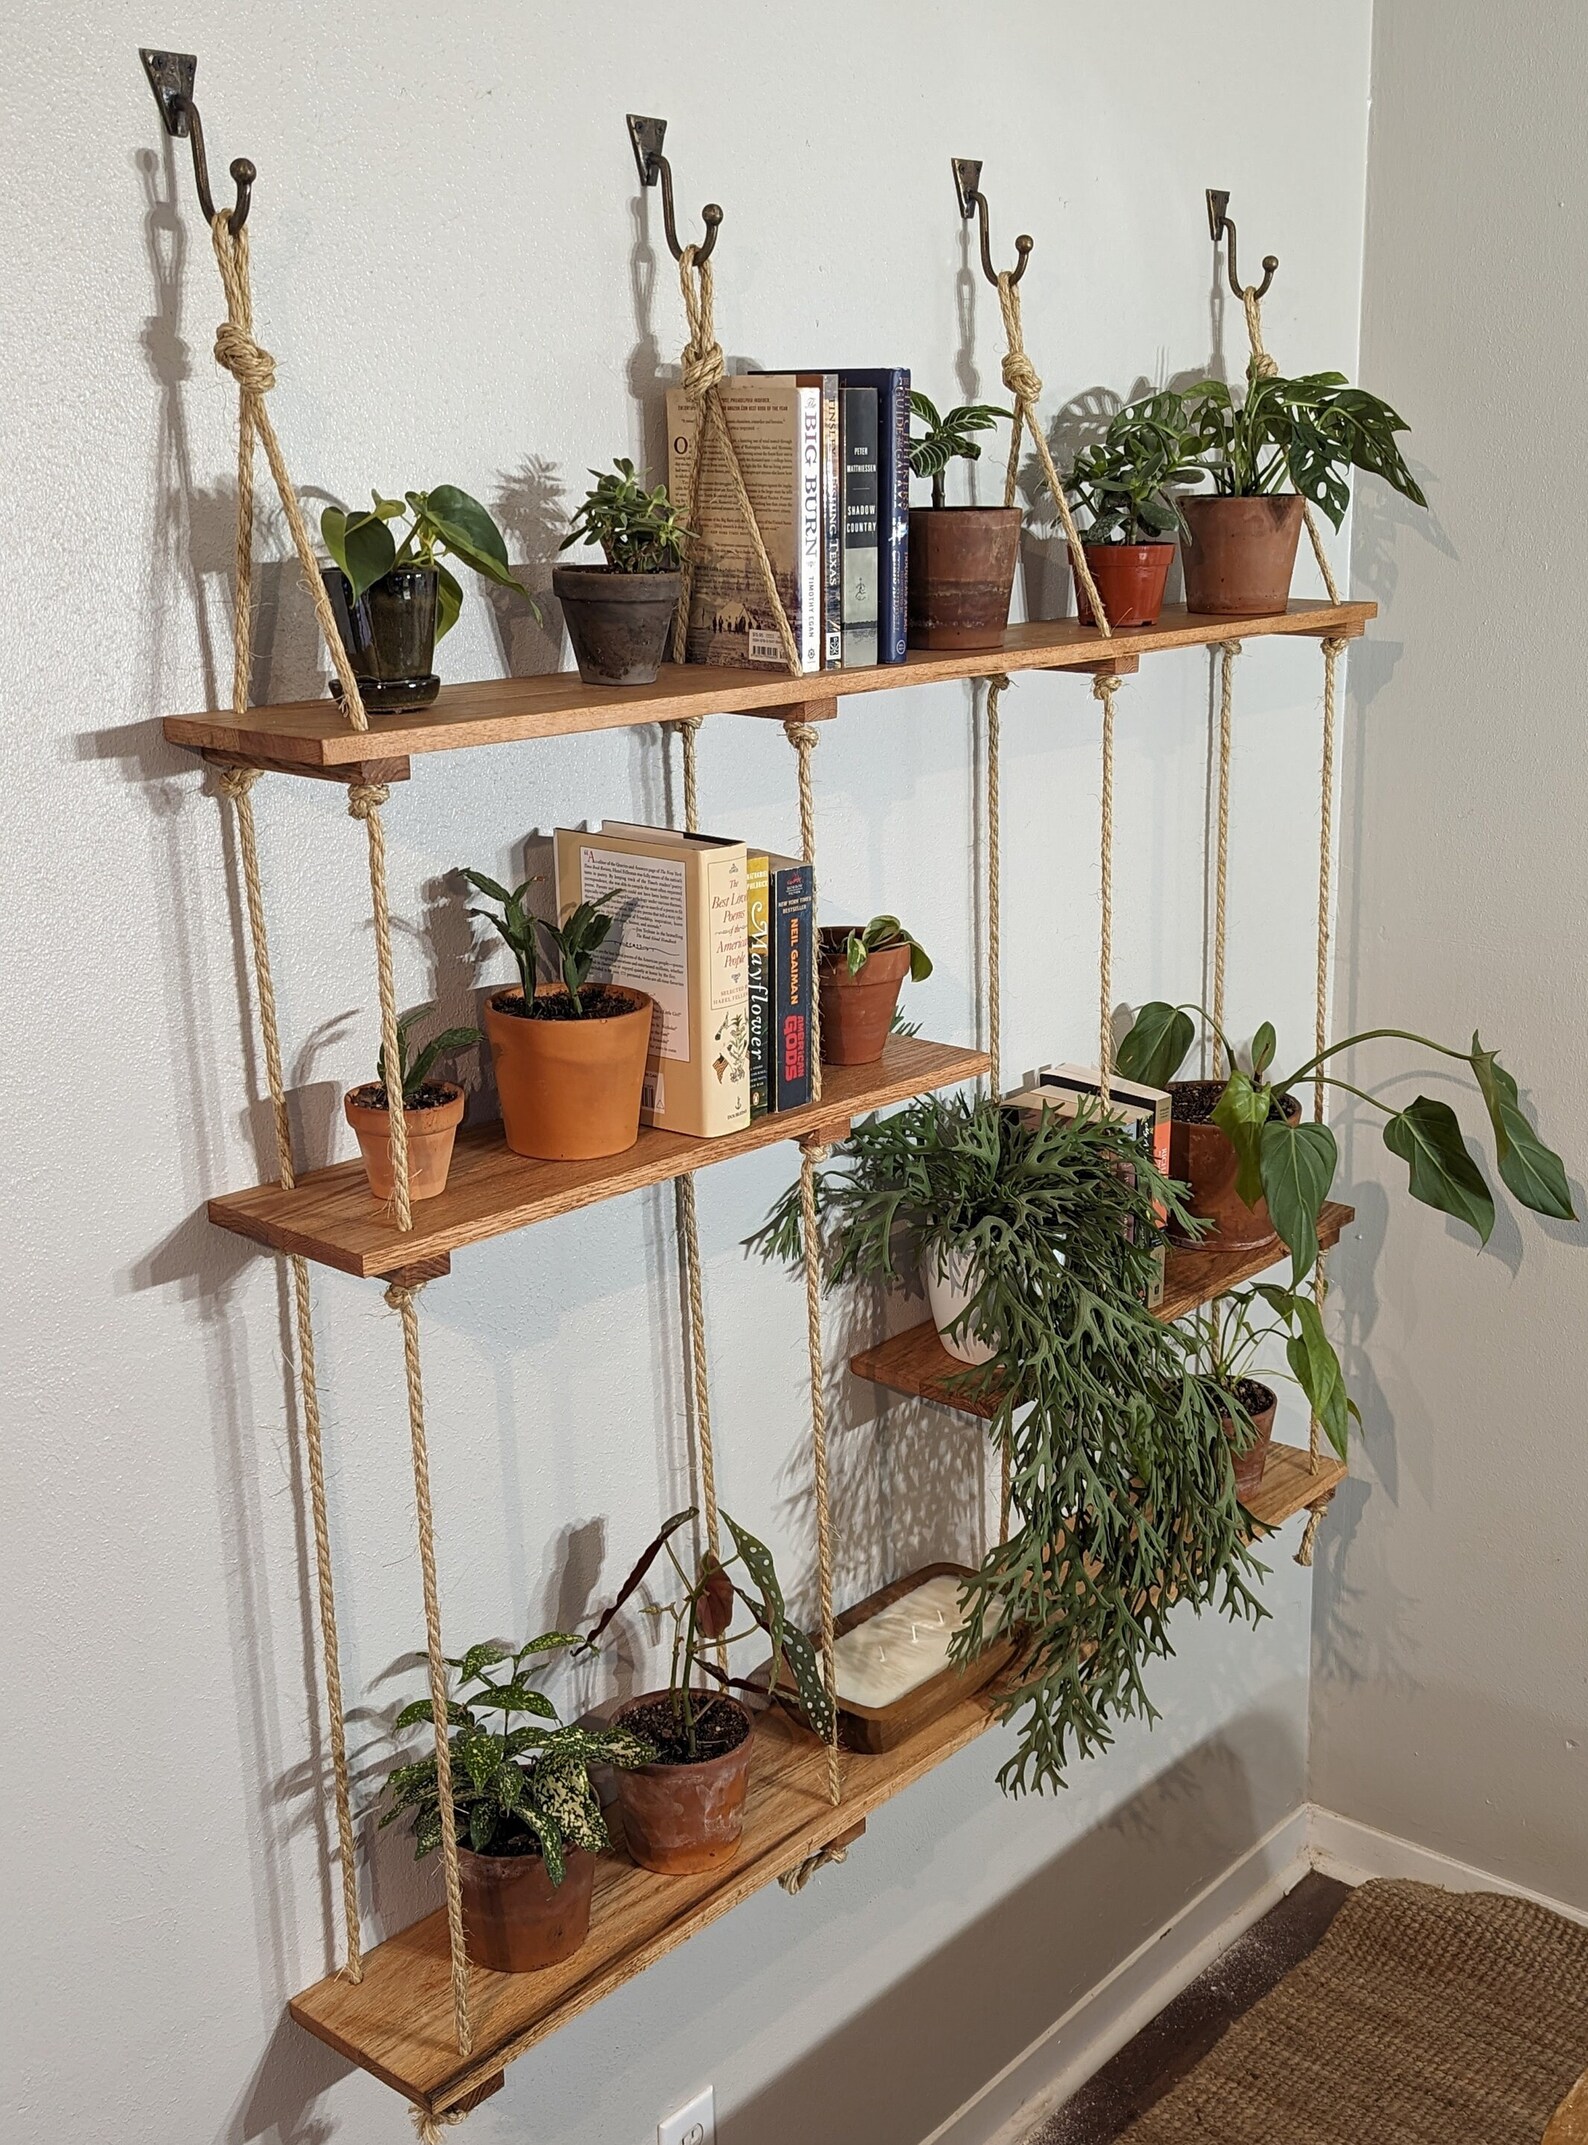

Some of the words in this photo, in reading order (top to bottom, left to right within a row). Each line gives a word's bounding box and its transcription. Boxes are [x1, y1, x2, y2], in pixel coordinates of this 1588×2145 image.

[805, 412, 817, 466] BIG
[805, 475, 817, 557] BURN
[847, 505, 876, 516] SHADOW
[846, 522, 876, 533] COUNTRY
[830, 538, 839, 586] TEXAS
[729, 879, 739, 889] The
[712, 896, 730, 909] Best
[783, 904, 806, 914] BESTSELLER
[723, 910, 746, 923] Poems
[790, 918, 798, 947] NEIL
[724, 951, 746, 968] People
[748, 901, 768, 1060] Mayflower
[790, 949, 798, 1005] GAIMAN
[784, 1015, 798, 1082] GODS
